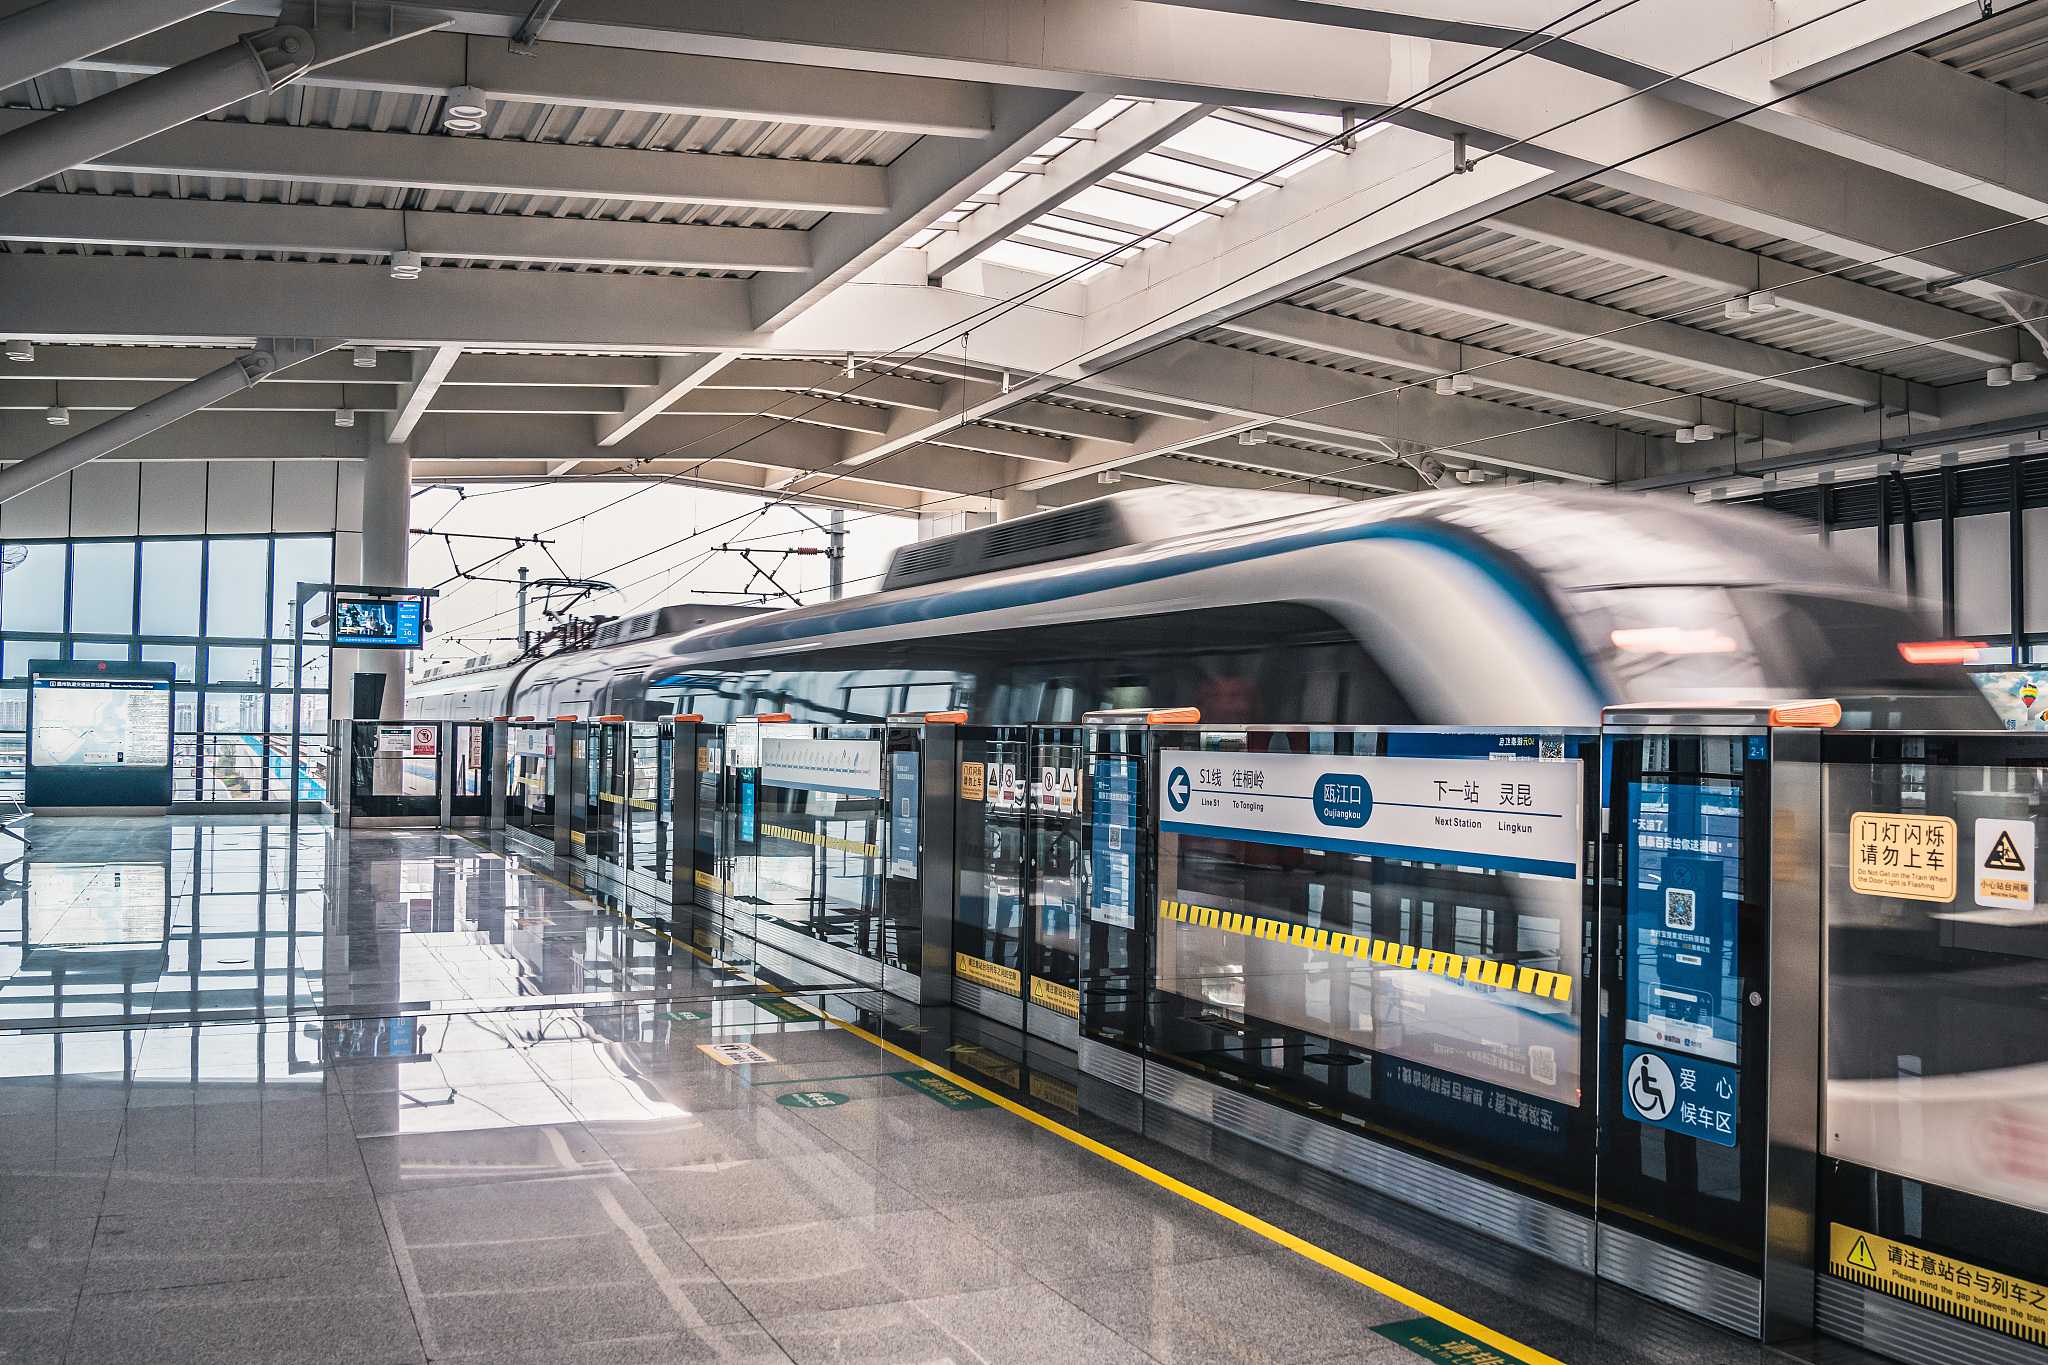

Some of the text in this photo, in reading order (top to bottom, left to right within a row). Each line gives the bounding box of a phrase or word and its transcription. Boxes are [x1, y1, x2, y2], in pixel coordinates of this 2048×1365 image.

[1750, 746, 1764, 756] 2-1
[1200, 768, 1264, 789] S1线 往桐岭
[1324, 784, 1361, 804] 瓯江口
[1434, 780, 1532, 806] 下一站 灵昆
[1202, 798, 1264, 812] Line S1 To Tongling
[1324, 808, 1361, 820] Oujiangkou
[1434, 816, 1532, 834] Next Station Lingkun
[1861, 821, 1944, 847] 门灯闪烁
[1861, 844, 1944, 871] 请勿上车
[1885, 878, 1900, 887] Light
[1908, 880, 1935, 890] Flashing
[1911, 873, 1927, 881] Train
[1929, 875, 1947, 883] When
[1981, 880, 2029, 892] 小心站台间隙
[1680, 1068, 1732, 1099] 爱 心
[1680, 1101, 1732, 1133] 候车区
[1888, 1244, 2048, 1310] 请注意站台与列车之
[1892, 1269, 2046, 1325] Please mind the gap between the train
